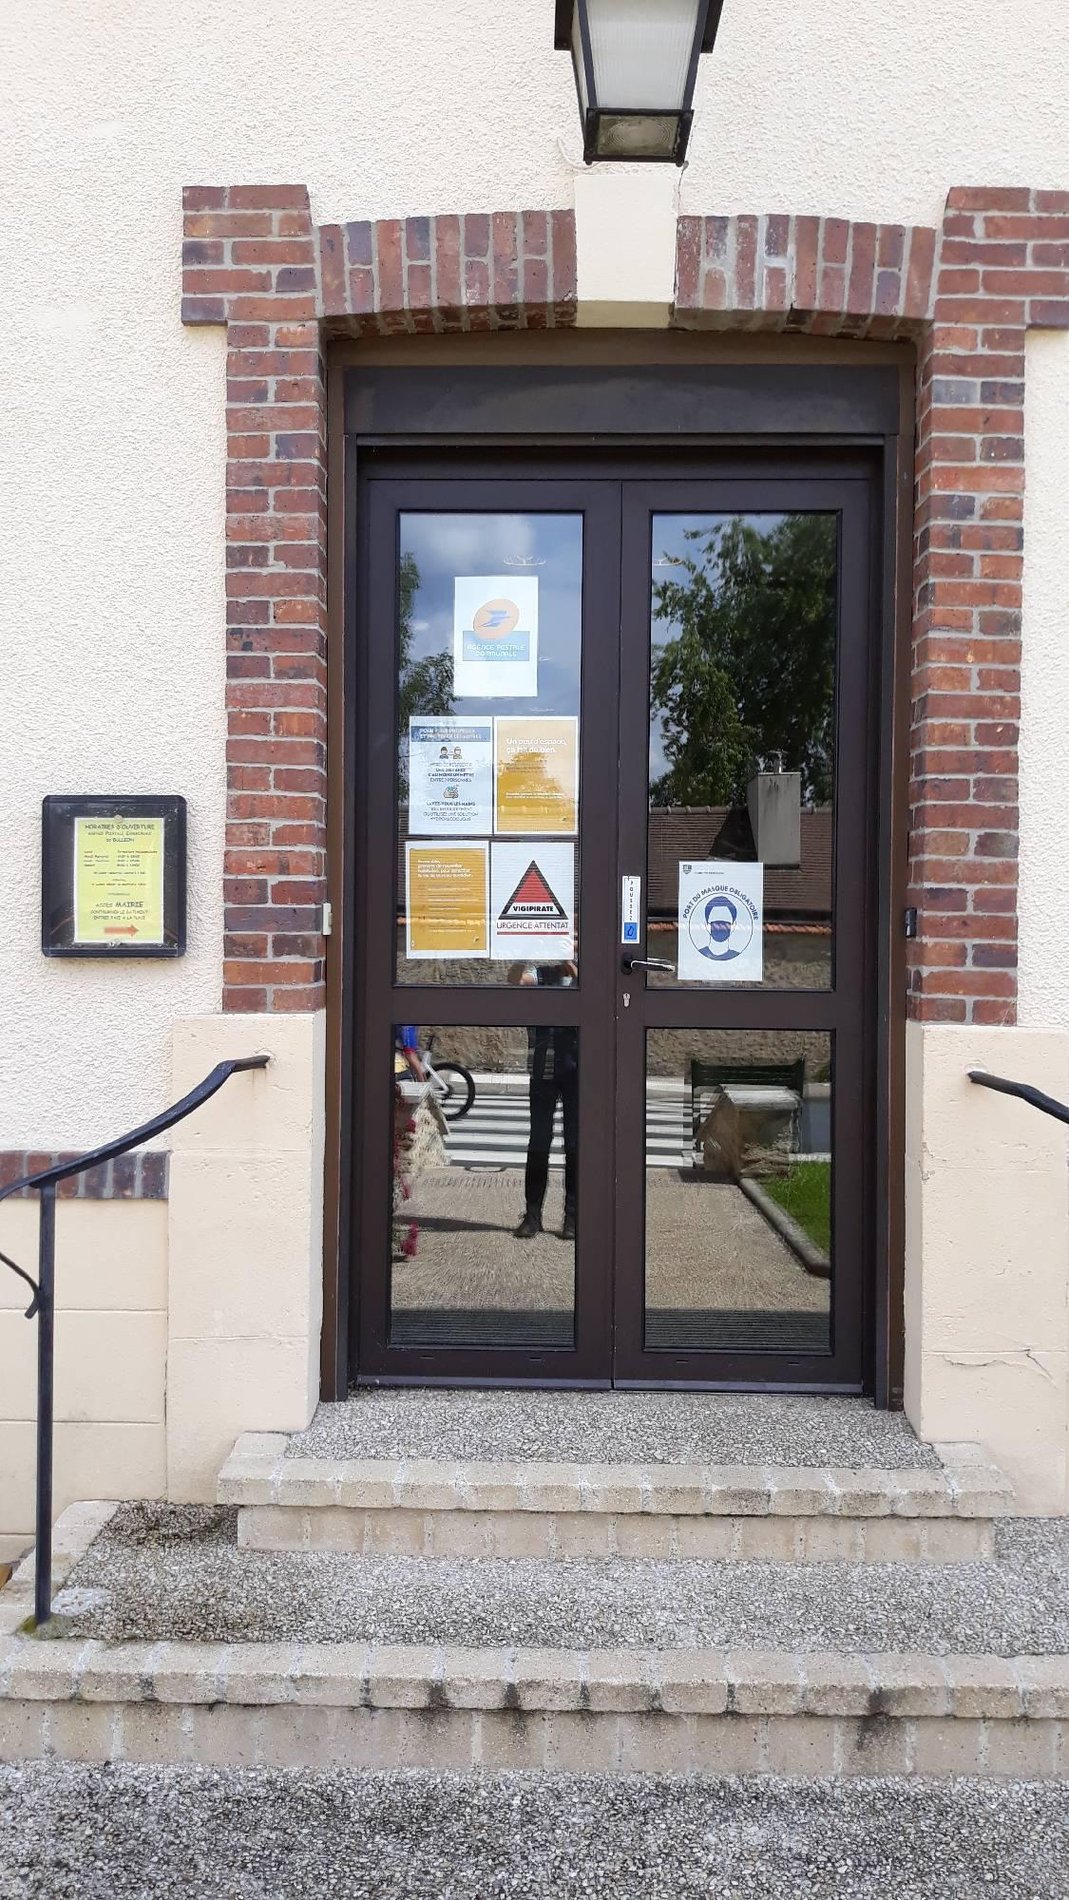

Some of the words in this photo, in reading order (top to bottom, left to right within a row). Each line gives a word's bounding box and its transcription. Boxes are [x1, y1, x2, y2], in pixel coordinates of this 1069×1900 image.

[683, 900, 694, 918] PORT
[692, 892, 701, 901] DU
[701, 886, 728, 895] MASQUE
[729, 887, 759, 920] OBLIGATOIRE
